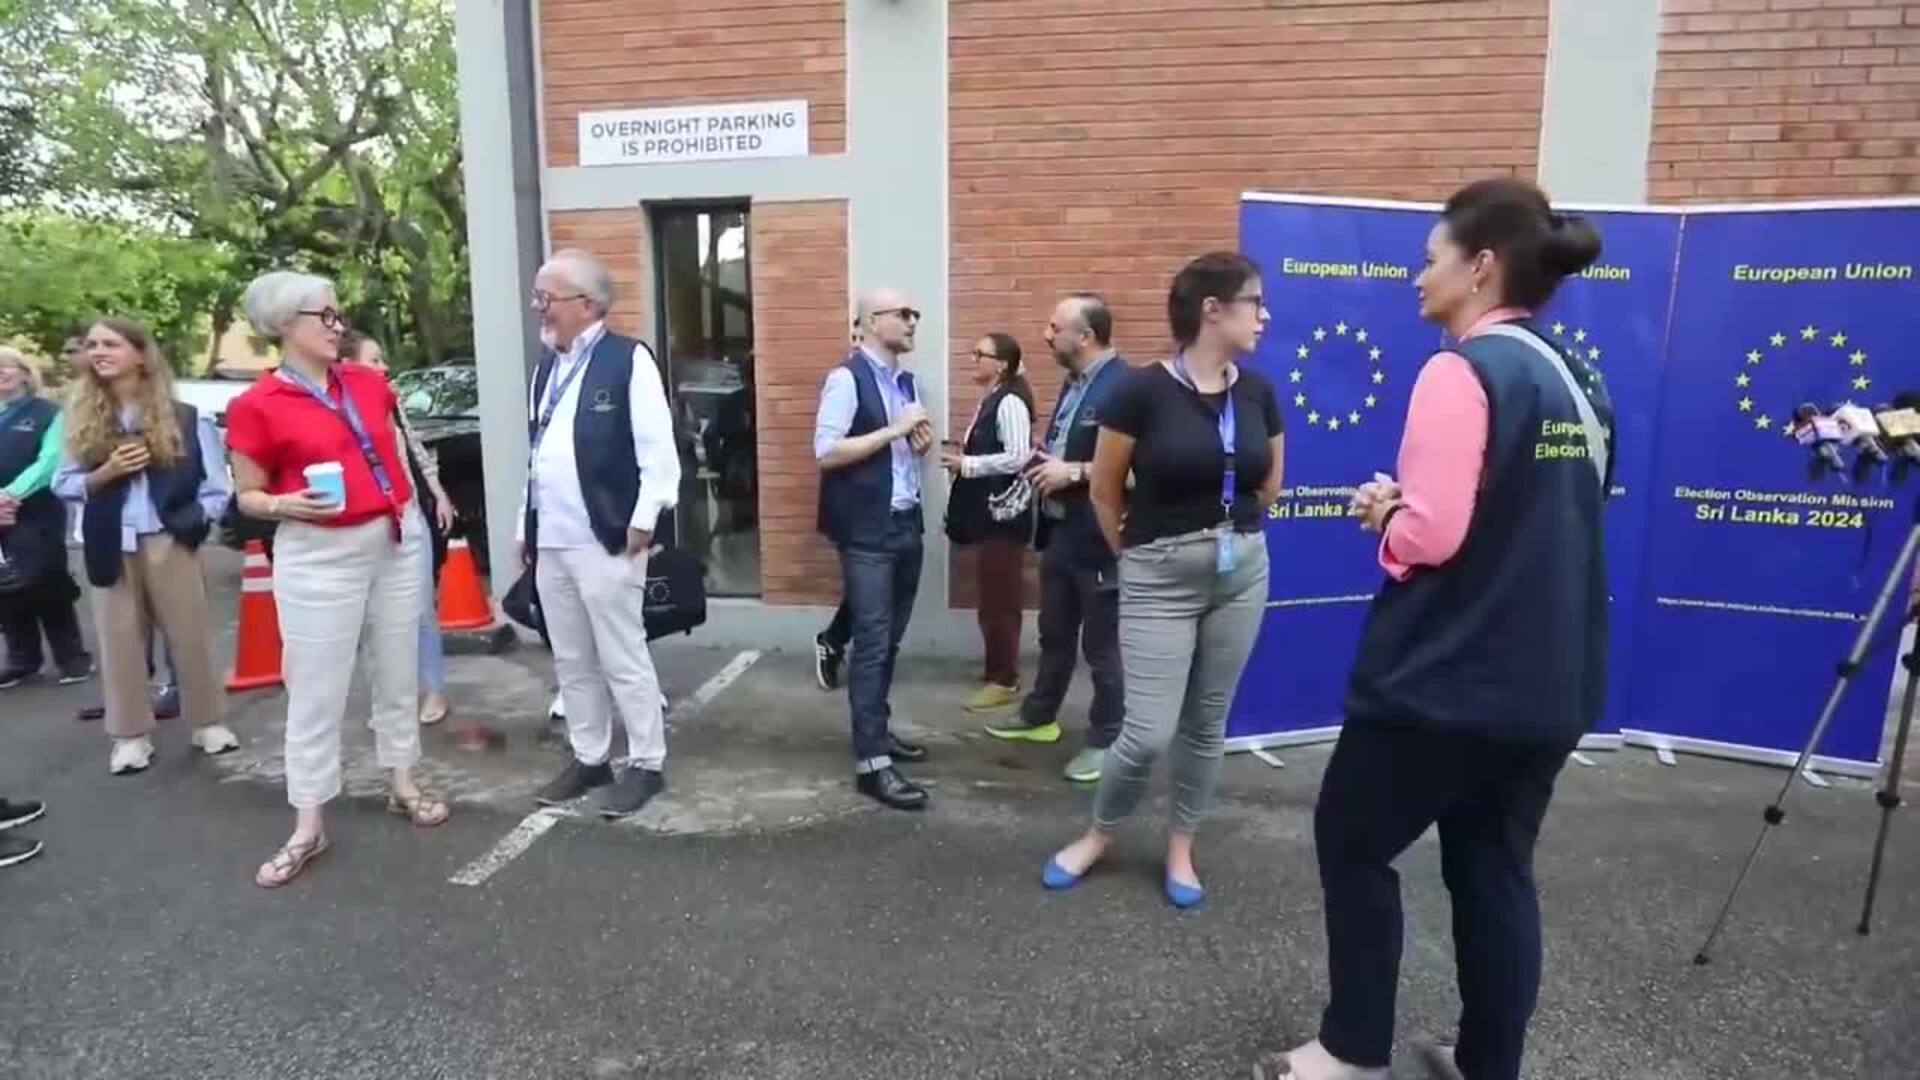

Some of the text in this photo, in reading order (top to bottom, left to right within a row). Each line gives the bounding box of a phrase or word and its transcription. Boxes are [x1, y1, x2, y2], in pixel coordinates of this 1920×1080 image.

[591, 112, 796, 138] OVERNIGHT PARKING
[622, 134, 763, 156] IS PROHIBITED
[1283, 257, 1408, 278] European Union
[1581, 264, 1631, 280] Union
[1733, 263, 1913, 283] European Union
[1674, 486, 1895, 509] Election Observation Mission
[1267, 502, 1290, 519] Sri
[1294, 502, 1343, 517] Lanka
[1695, 503, 1865, 528] Sri Lanka 2024
